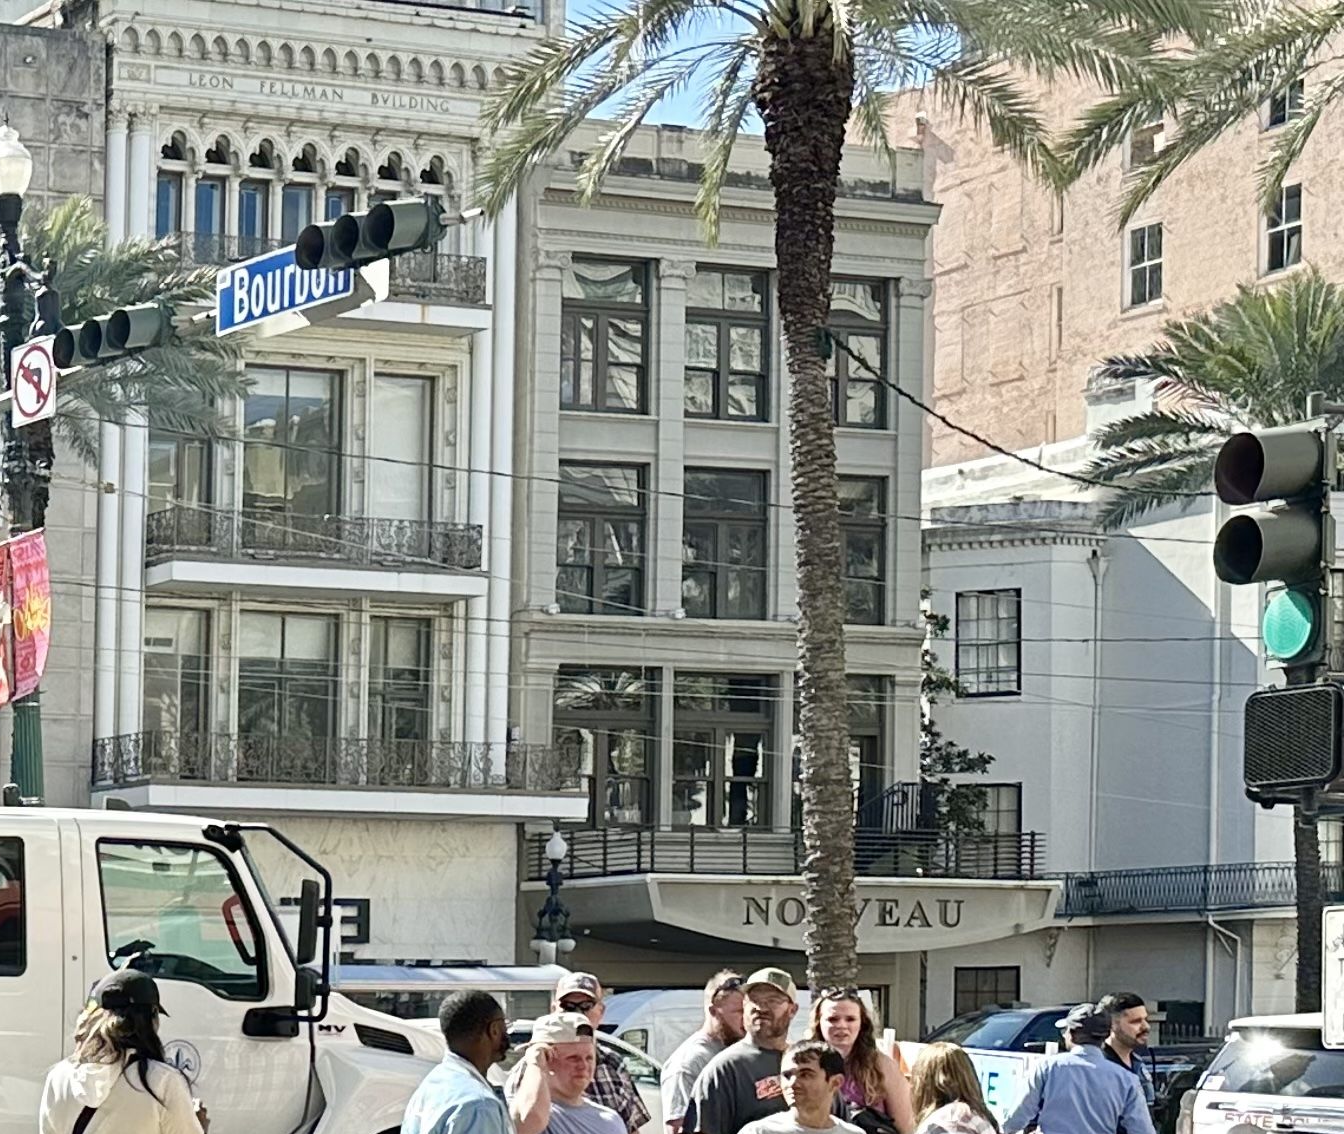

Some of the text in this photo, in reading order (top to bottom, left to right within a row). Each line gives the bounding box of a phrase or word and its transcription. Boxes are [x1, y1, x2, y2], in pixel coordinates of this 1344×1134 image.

[188, 72, 235, 90] LEON
[259, 80, 345, 101] FELLMAN
[232, 263, 346, 324] Bourbon
[742, 896, 965, 928] NOVEAU
